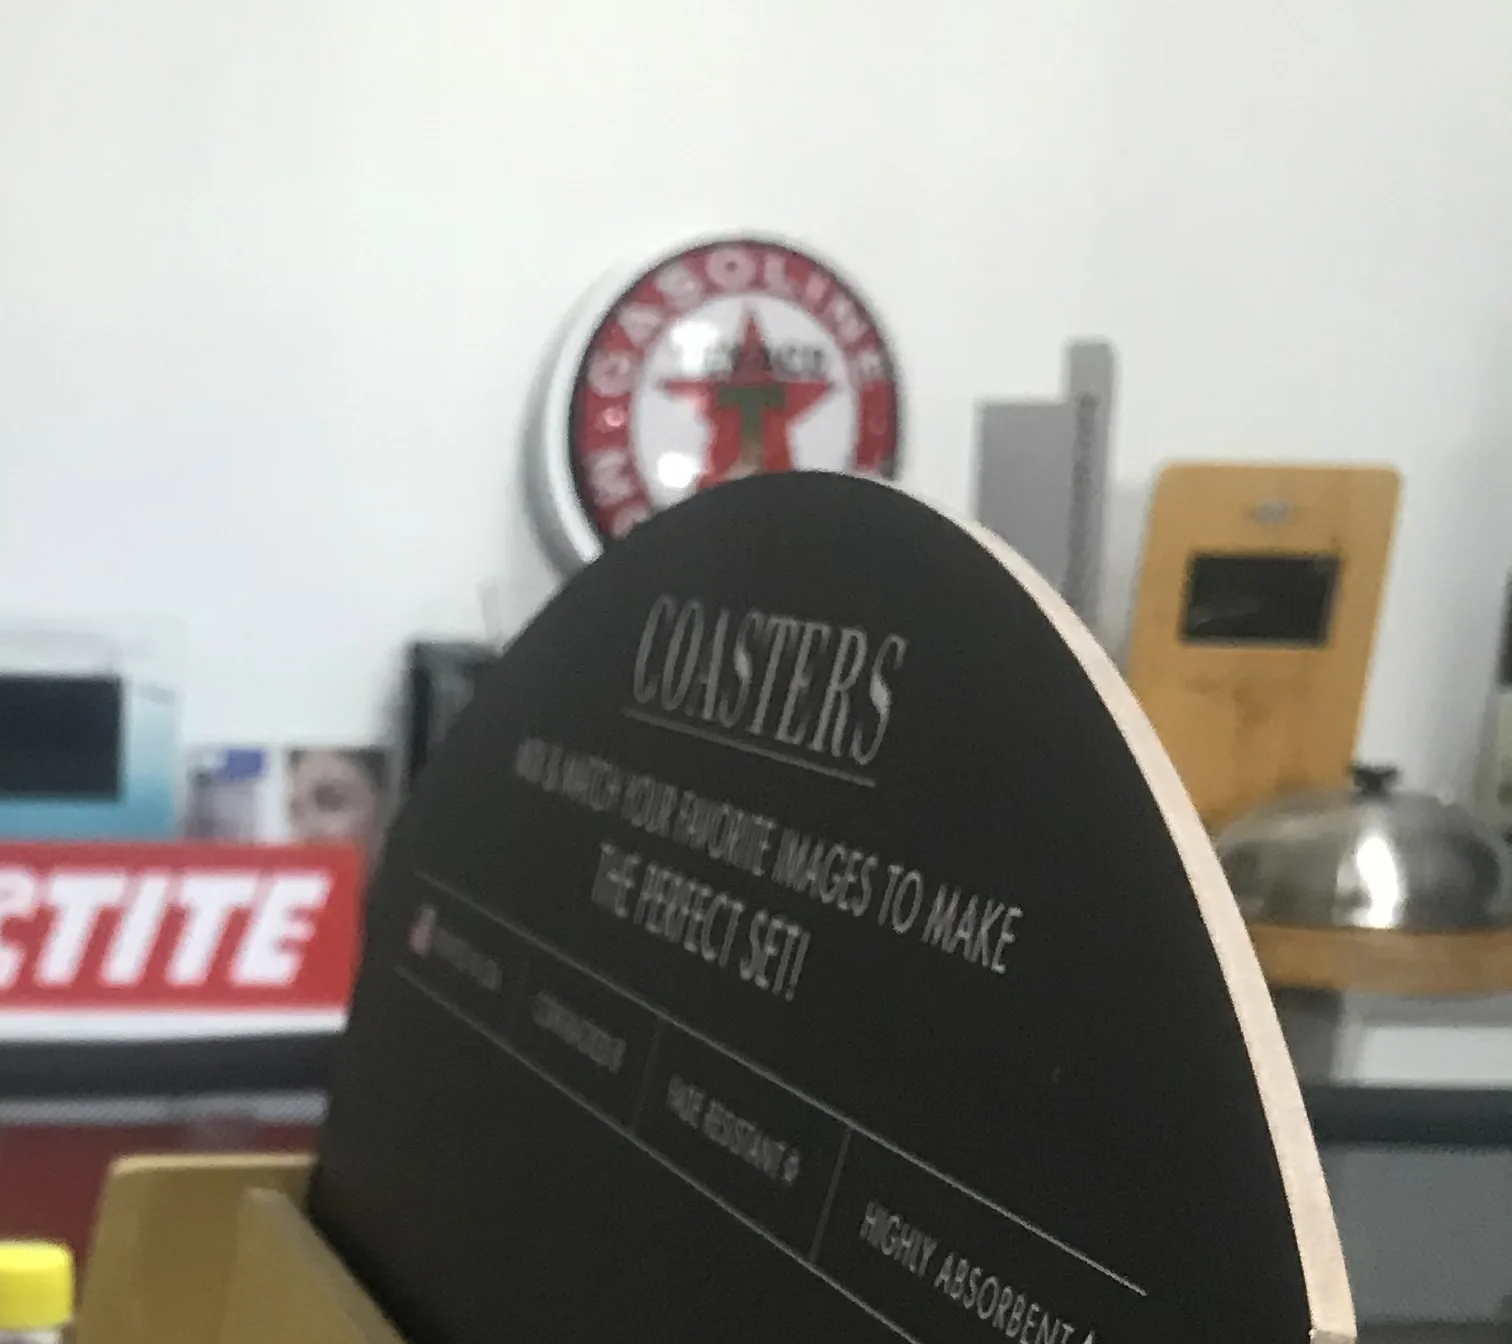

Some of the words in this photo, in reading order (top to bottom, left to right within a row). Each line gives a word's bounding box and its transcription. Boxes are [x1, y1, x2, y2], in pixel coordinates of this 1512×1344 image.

[633, 593, 909, 765] COASTERS
[591, 840, 643, 919] THE
[633, 861, 746, 969] PERFECT
[739, 909, 812, 1003] SET!
[673, 788, 776, 877] FAVORITE
[771, 828, 879, 917] IMAGES
[877, 863, 926, 935] TO
[920, 882, 1025, 975] MAKE
[859, 1199, 938, 1280] HIGHLY
